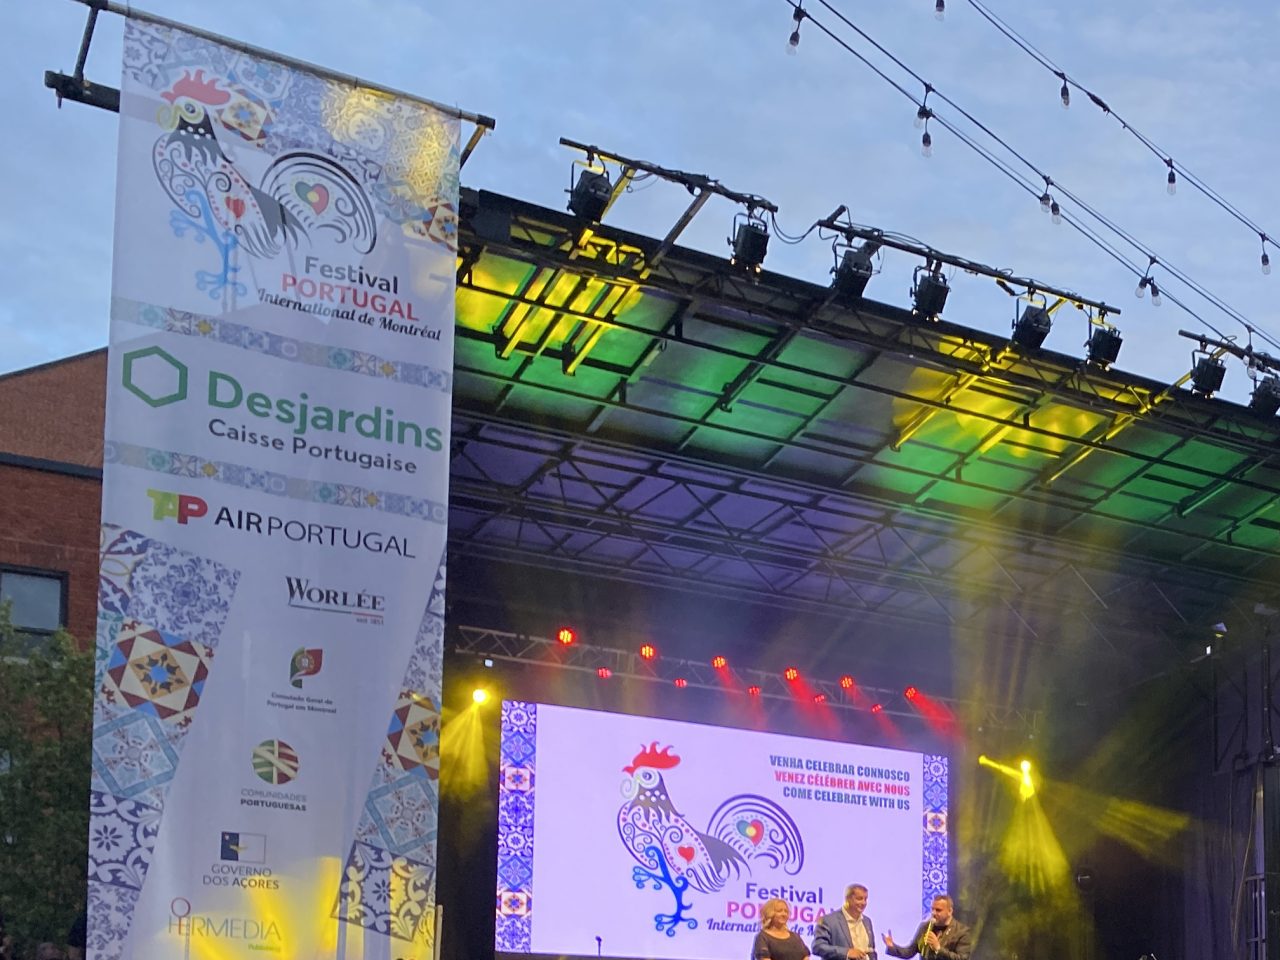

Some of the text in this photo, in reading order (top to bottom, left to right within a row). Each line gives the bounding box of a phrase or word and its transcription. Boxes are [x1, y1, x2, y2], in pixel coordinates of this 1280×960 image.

[305, 255, 398, 294] Festival
[282, 273, 420, 321] PORTUGAL
[258, 288, 442, 341] International de Montréal
[208, 370, 443, 452] Desjardins
[208, 418, 418, 474] Caisse Portugaise
[147, 489, 209, 525] TAP
[769, 755, 910, 782] VENHA CELEBRAR CONNOSCO
[774, 770, 910, 796] VENEZ CÉLÉBRER AVEC NOUS
[240, 798, 307, 811] PORTUGUESAS
[783, 786, 910, 811] COME CELEBRATE WITH US
[202, 875, 279, 890] DOS AÇORES
[211, 863, 272, 878] GOVERNO
[745, 882, 823, 904] Festival
[706, 918, 760, 932] Internat
